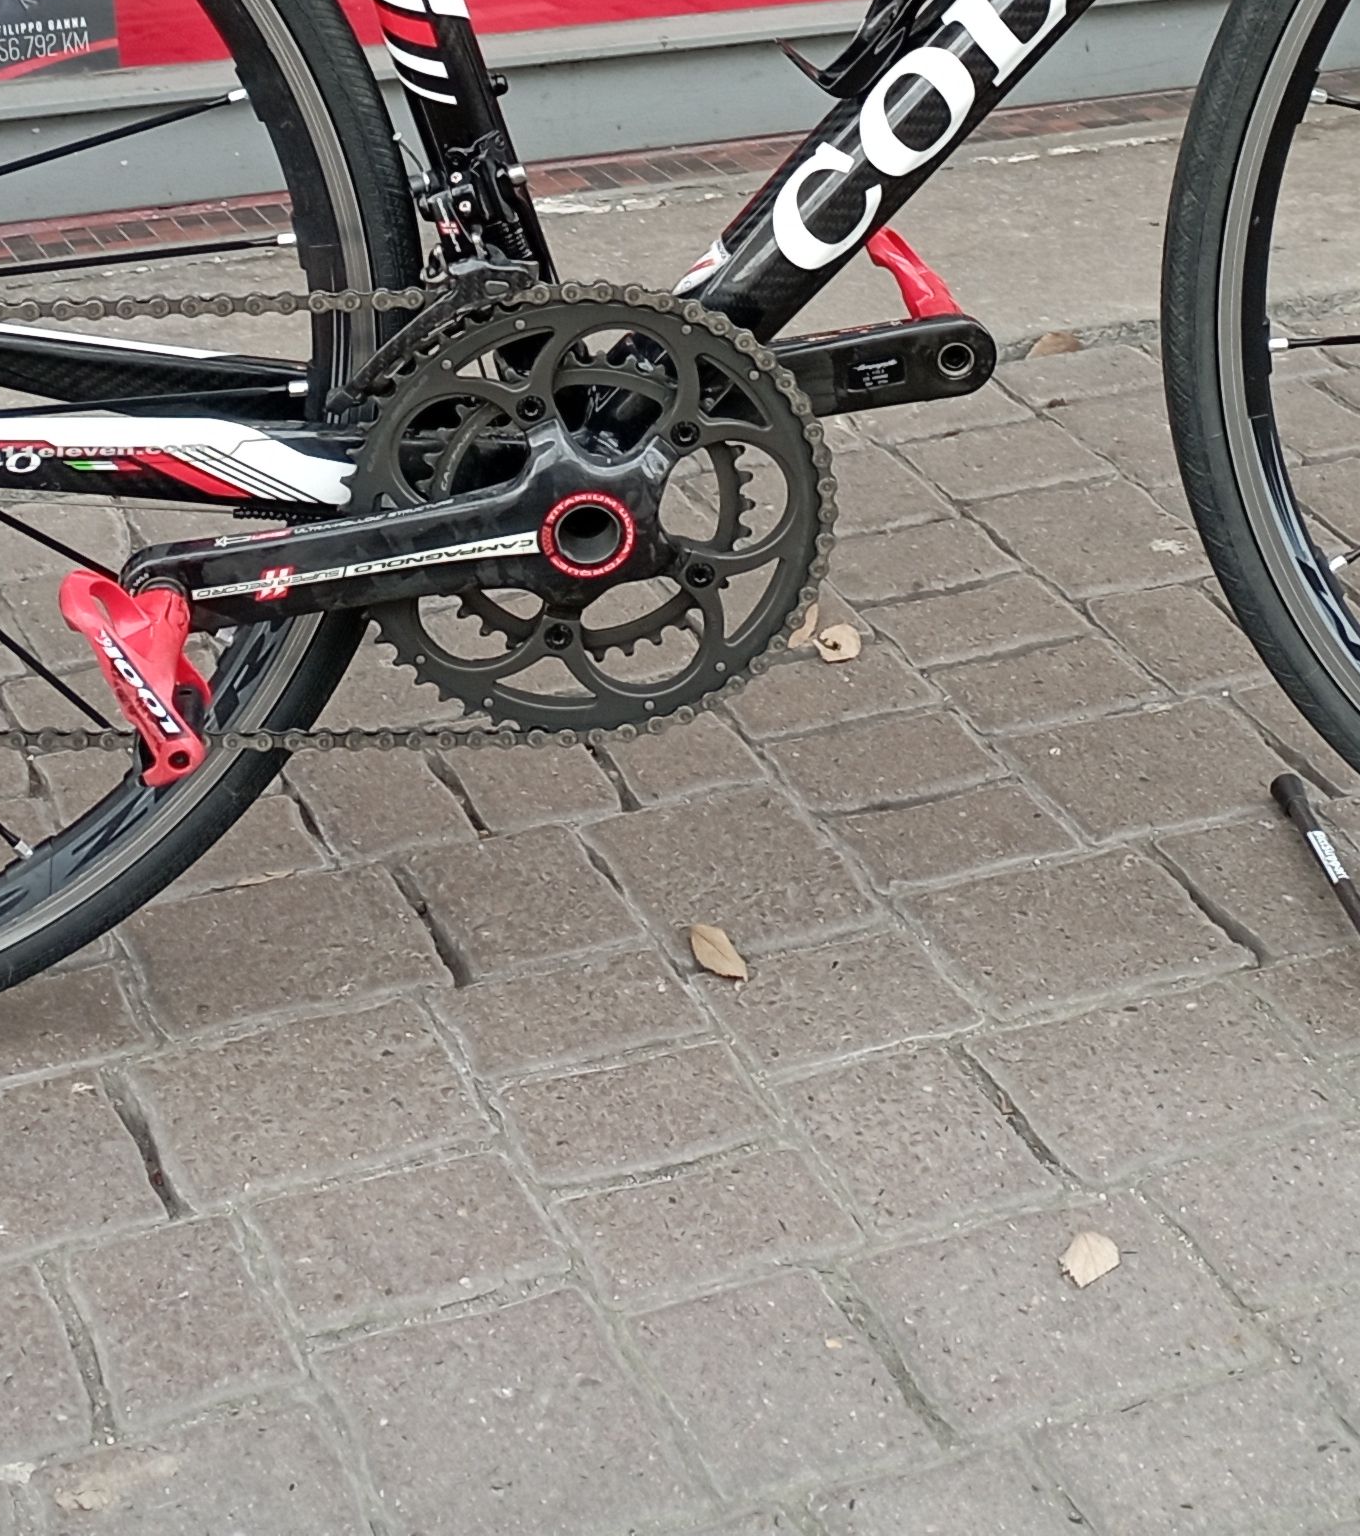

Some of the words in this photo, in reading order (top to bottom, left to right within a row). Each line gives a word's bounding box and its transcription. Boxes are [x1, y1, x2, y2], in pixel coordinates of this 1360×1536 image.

[47, 16, 88, 31] GANNA
[61, 31, 91, 54] KM
[354, 538, 535, 574] CAMPAGNOLO
